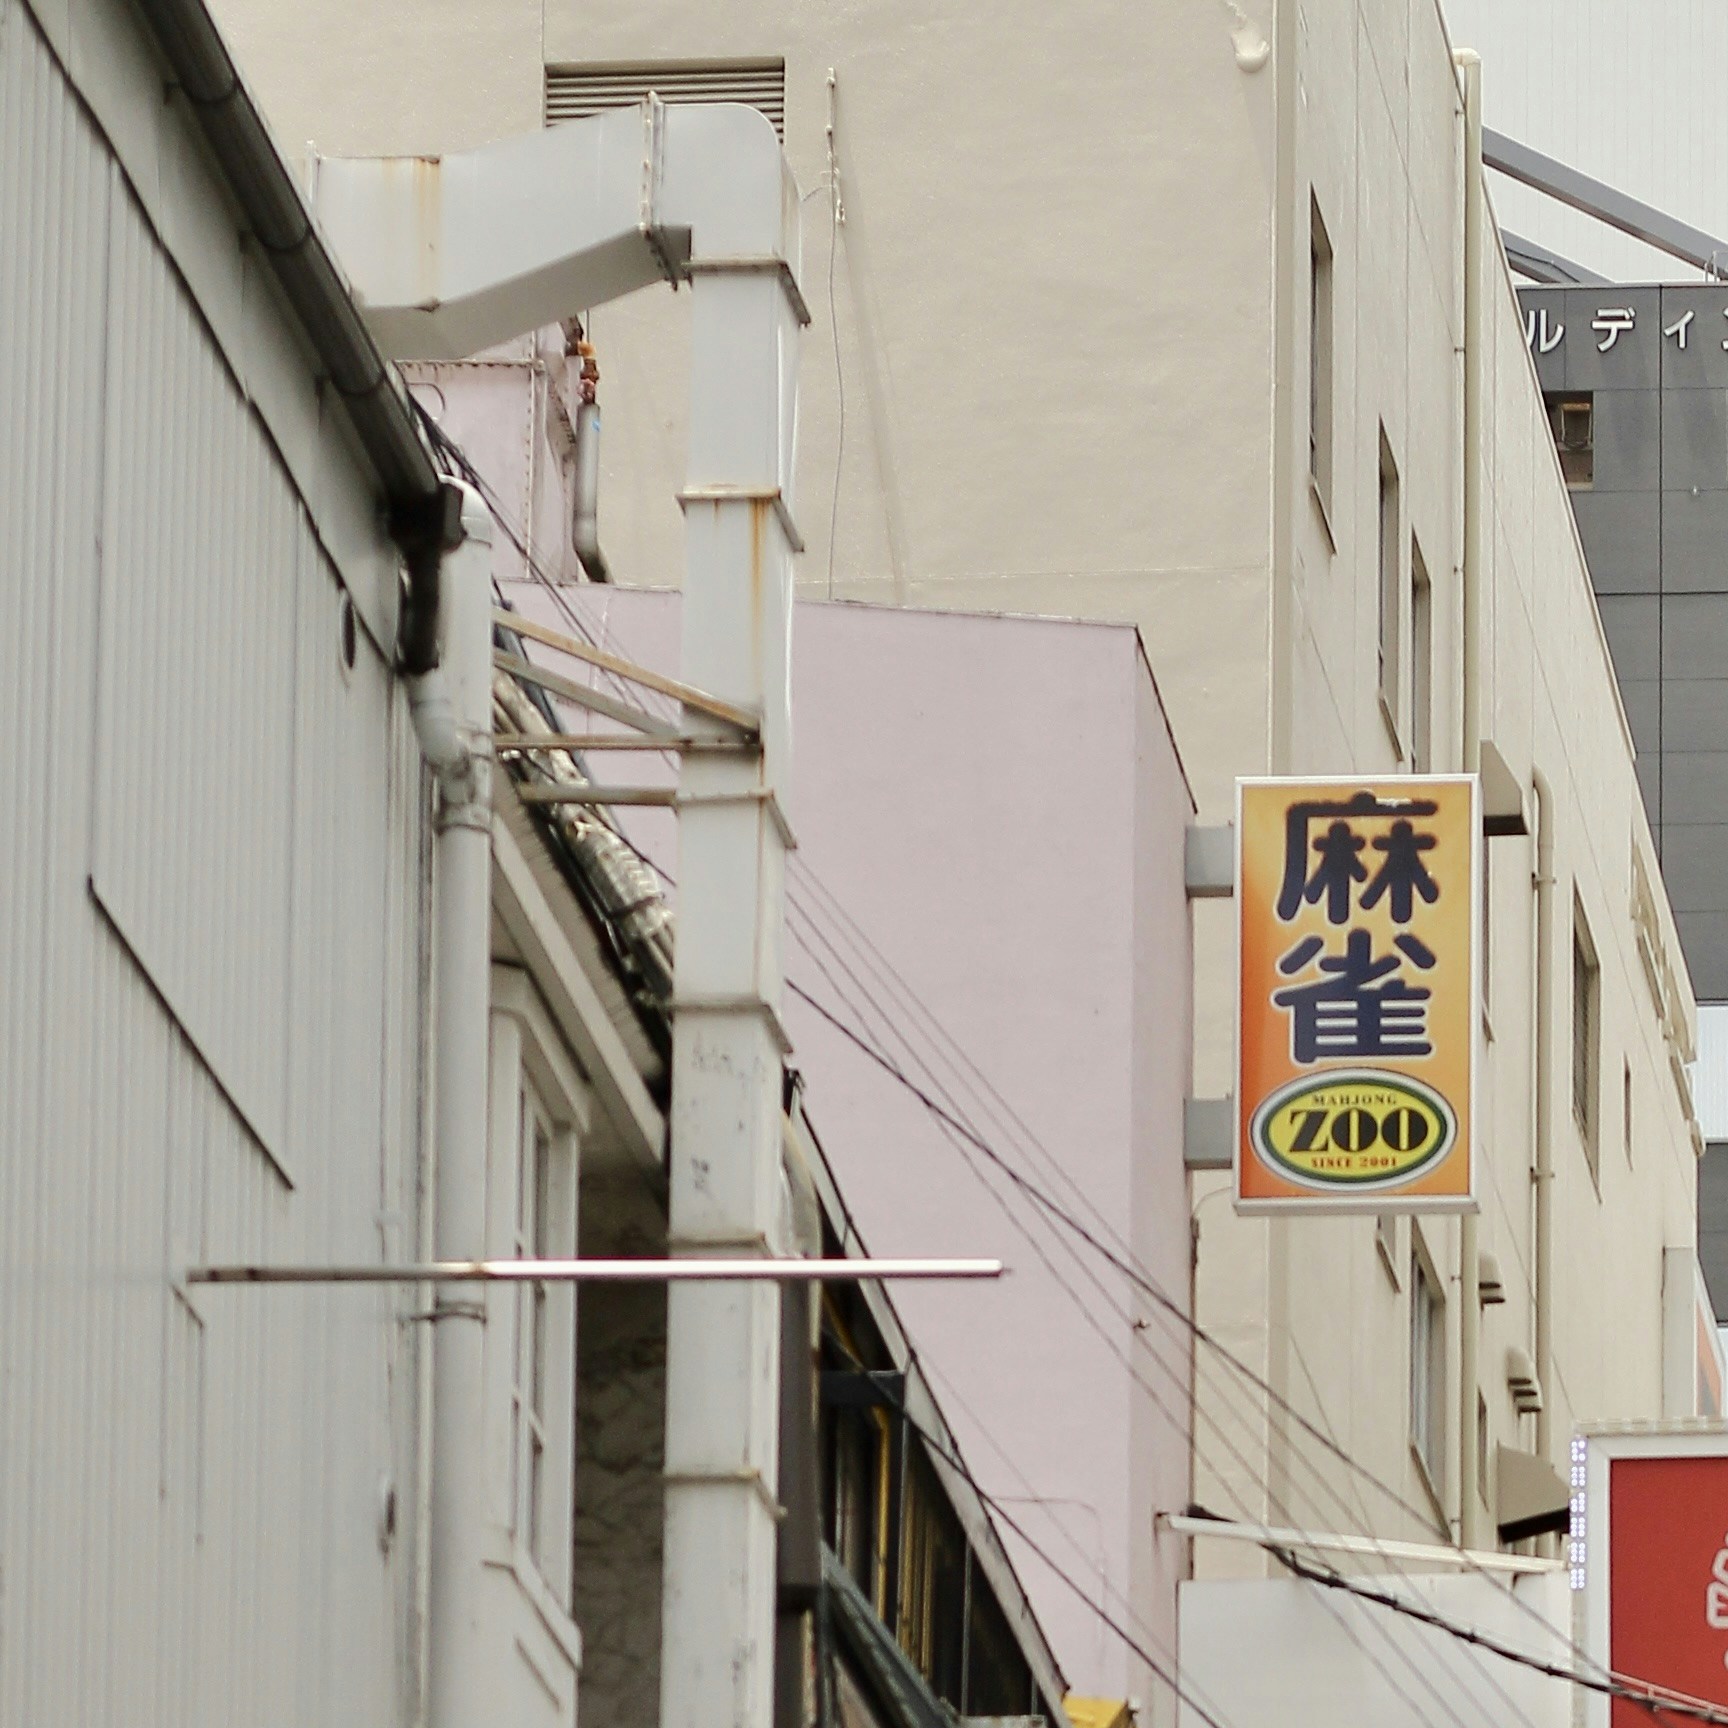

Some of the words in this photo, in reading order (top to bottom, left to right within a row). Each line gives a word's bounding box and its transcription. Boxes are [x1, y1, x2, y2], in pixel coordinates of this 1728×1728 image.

[1274, 788, 1440, 1064] 麻雀
[1311, 1092, 1397, 1106] MAHJONG
[1287, 1106, 1430, 1153] ZOO
[1310, 1156, 1352, 1169] SINCE
[1358, 1156, 1398, 1169] 2001
